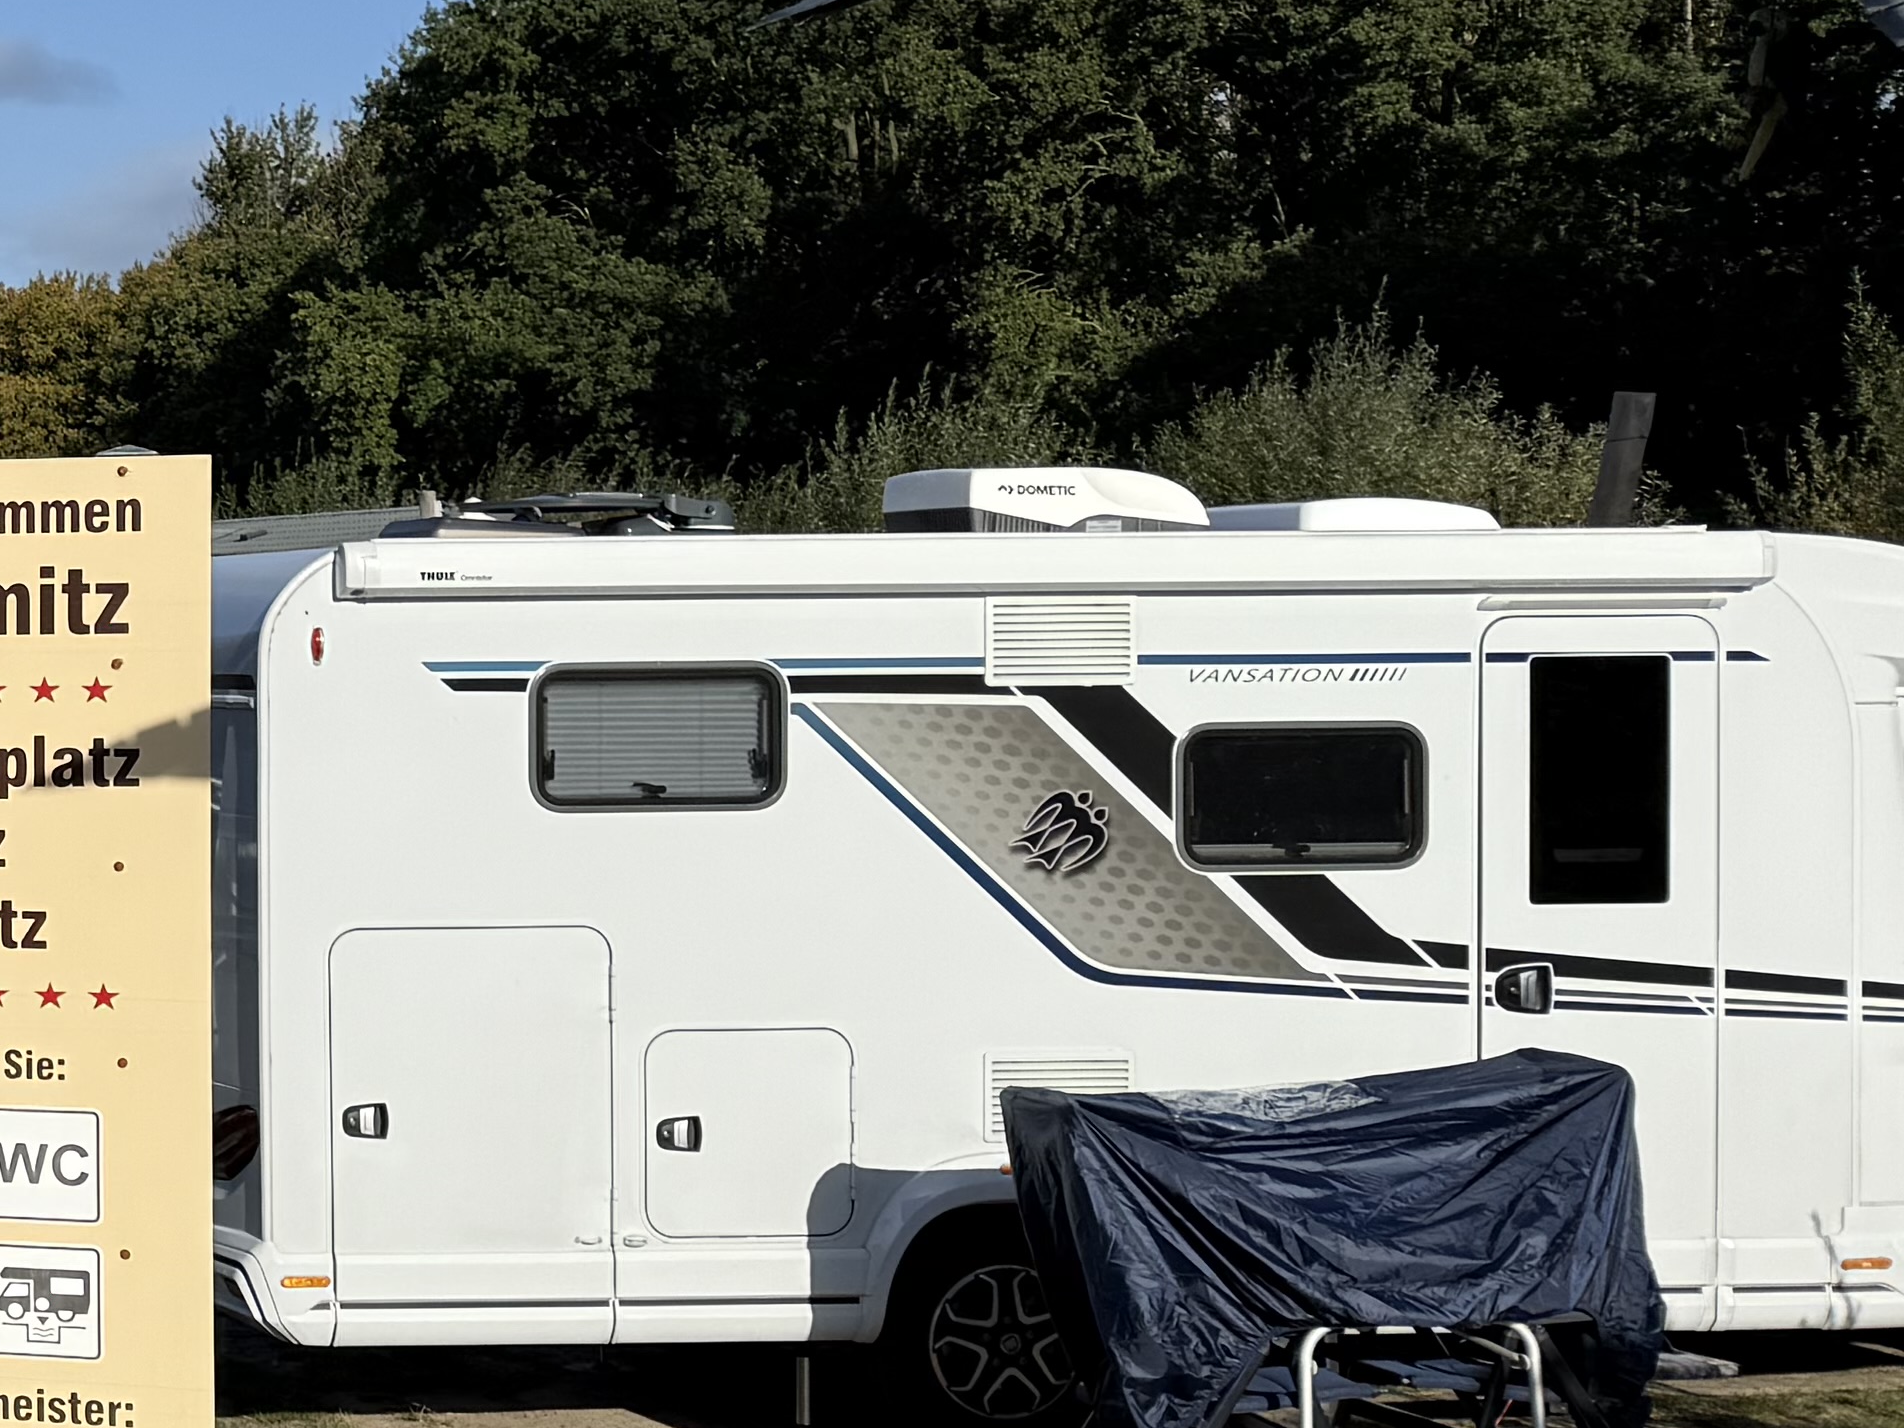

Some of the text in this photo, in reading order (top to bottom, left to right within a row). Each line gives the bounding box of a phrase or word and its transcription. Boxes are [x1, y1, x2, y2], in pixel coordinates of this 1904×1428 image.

[1017, 484, 1076, 496] DOMETIC
[420, 571, 456, 581] THULE
[1189, 667, 1344, 683] VANSATION
[4, 1049, 66, 1081] Sie:
